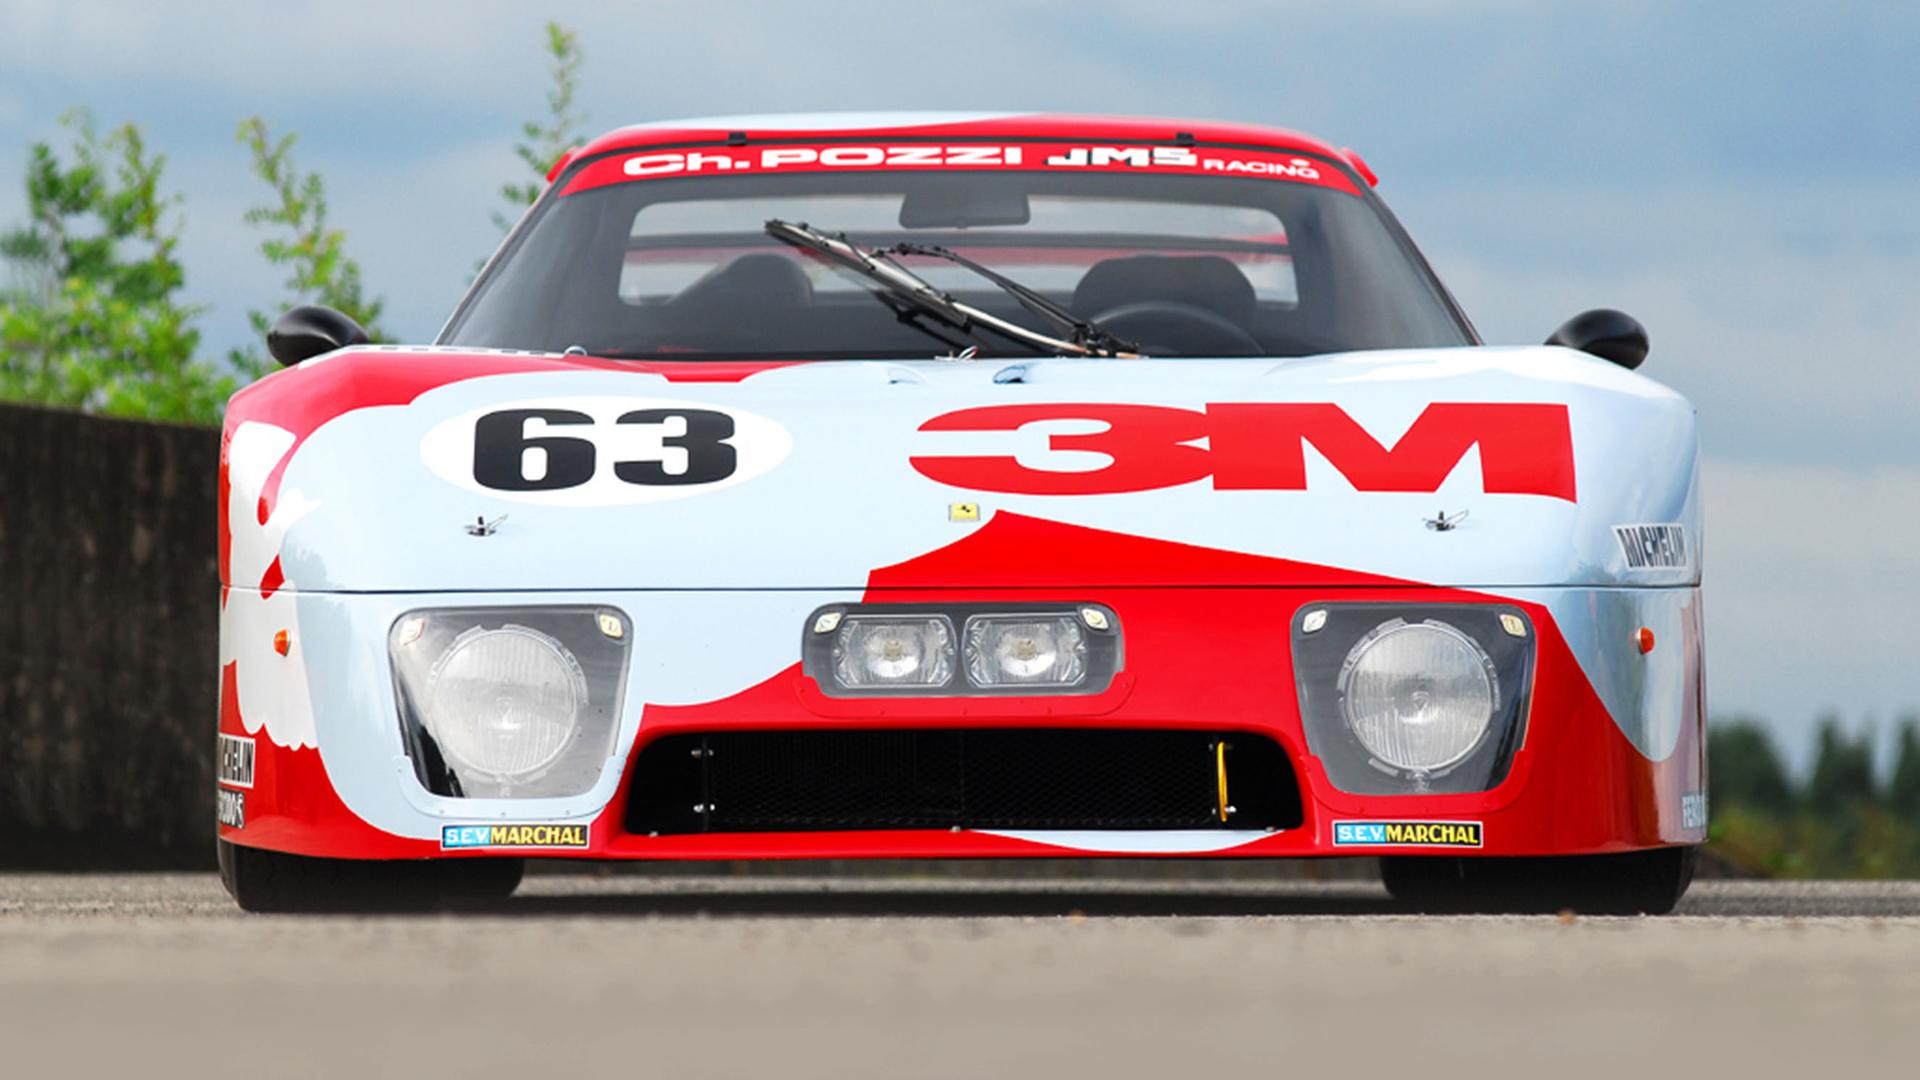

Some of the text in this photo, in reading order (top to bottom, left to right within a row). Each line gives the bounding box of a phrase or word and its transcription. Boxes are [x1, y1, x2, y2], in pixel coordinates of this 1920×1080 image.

[623, 152, 751, 176] Ch.
[761, 146, 1022, 168] POZZI
[1203, 158, 1321, 180] RACING
[473, 408, 738, 491] 63
[909, 402, 1577, 503] 3M
[1616, 526, 1687, 567] MICHELIN
[490, 826, 585, 845] MARCHAL
[1385, 824, 1479, 844] MARCHAL
